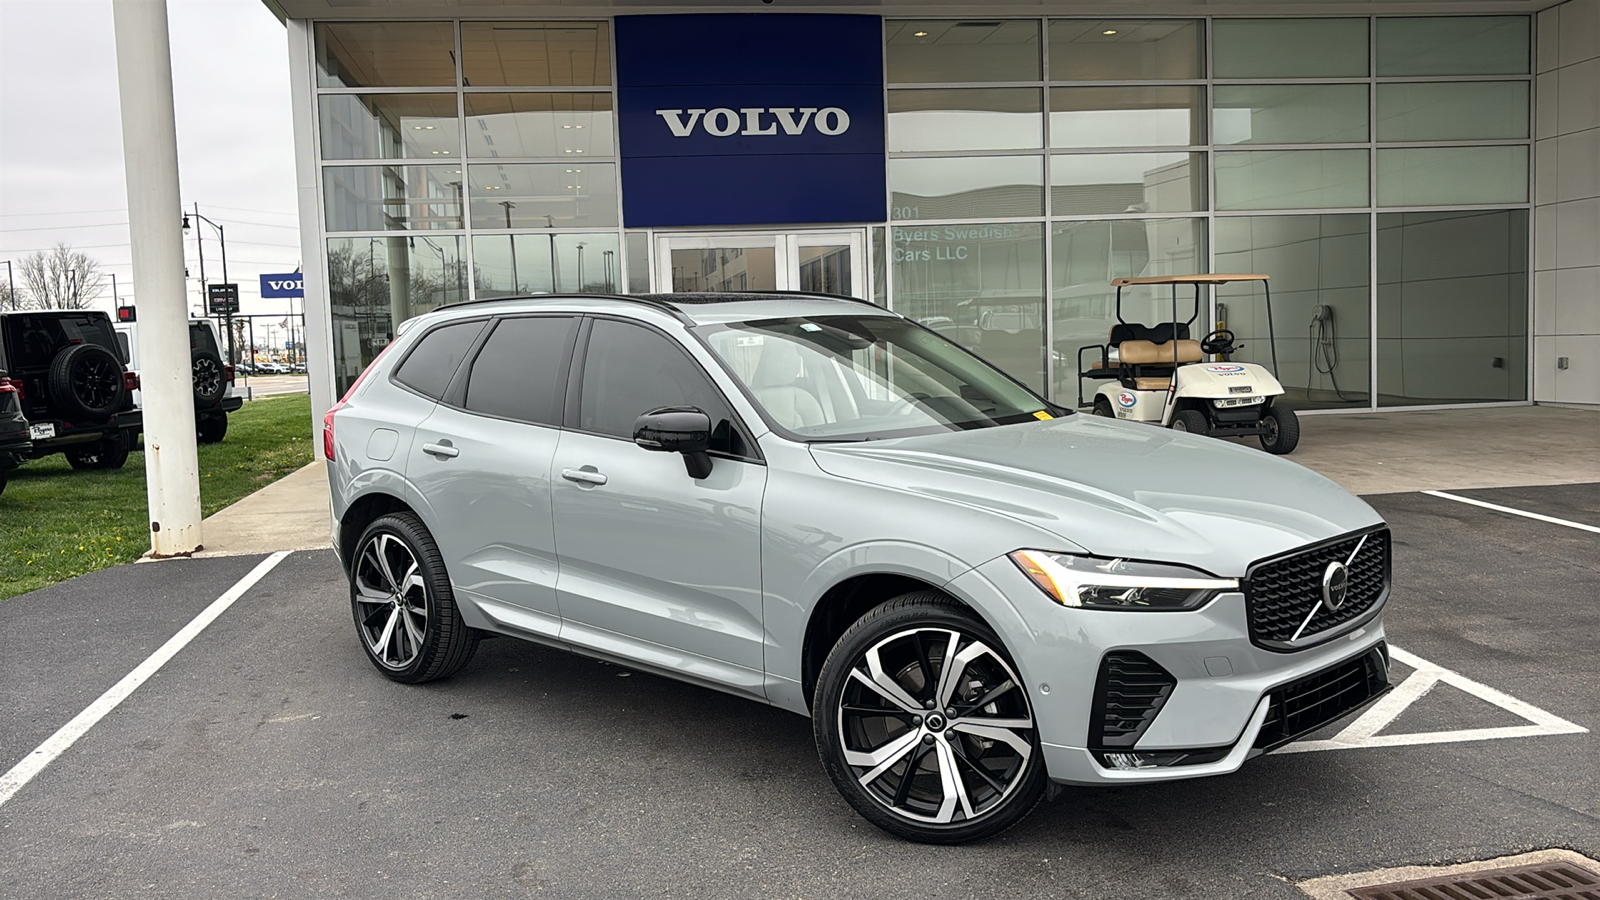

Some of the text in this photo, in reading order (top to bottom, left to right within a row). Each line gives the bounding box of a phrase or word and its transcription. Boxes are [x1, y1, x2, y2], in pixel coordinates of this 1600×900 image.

[655, 107, 850, 137] VOLVO
[893, 206, 919, 220] 301
[893, 226, 1013, 245] Byers Swedish
[893, 246, 968, 262] Cars LLC
[268, 280, 304, 290] VOL
